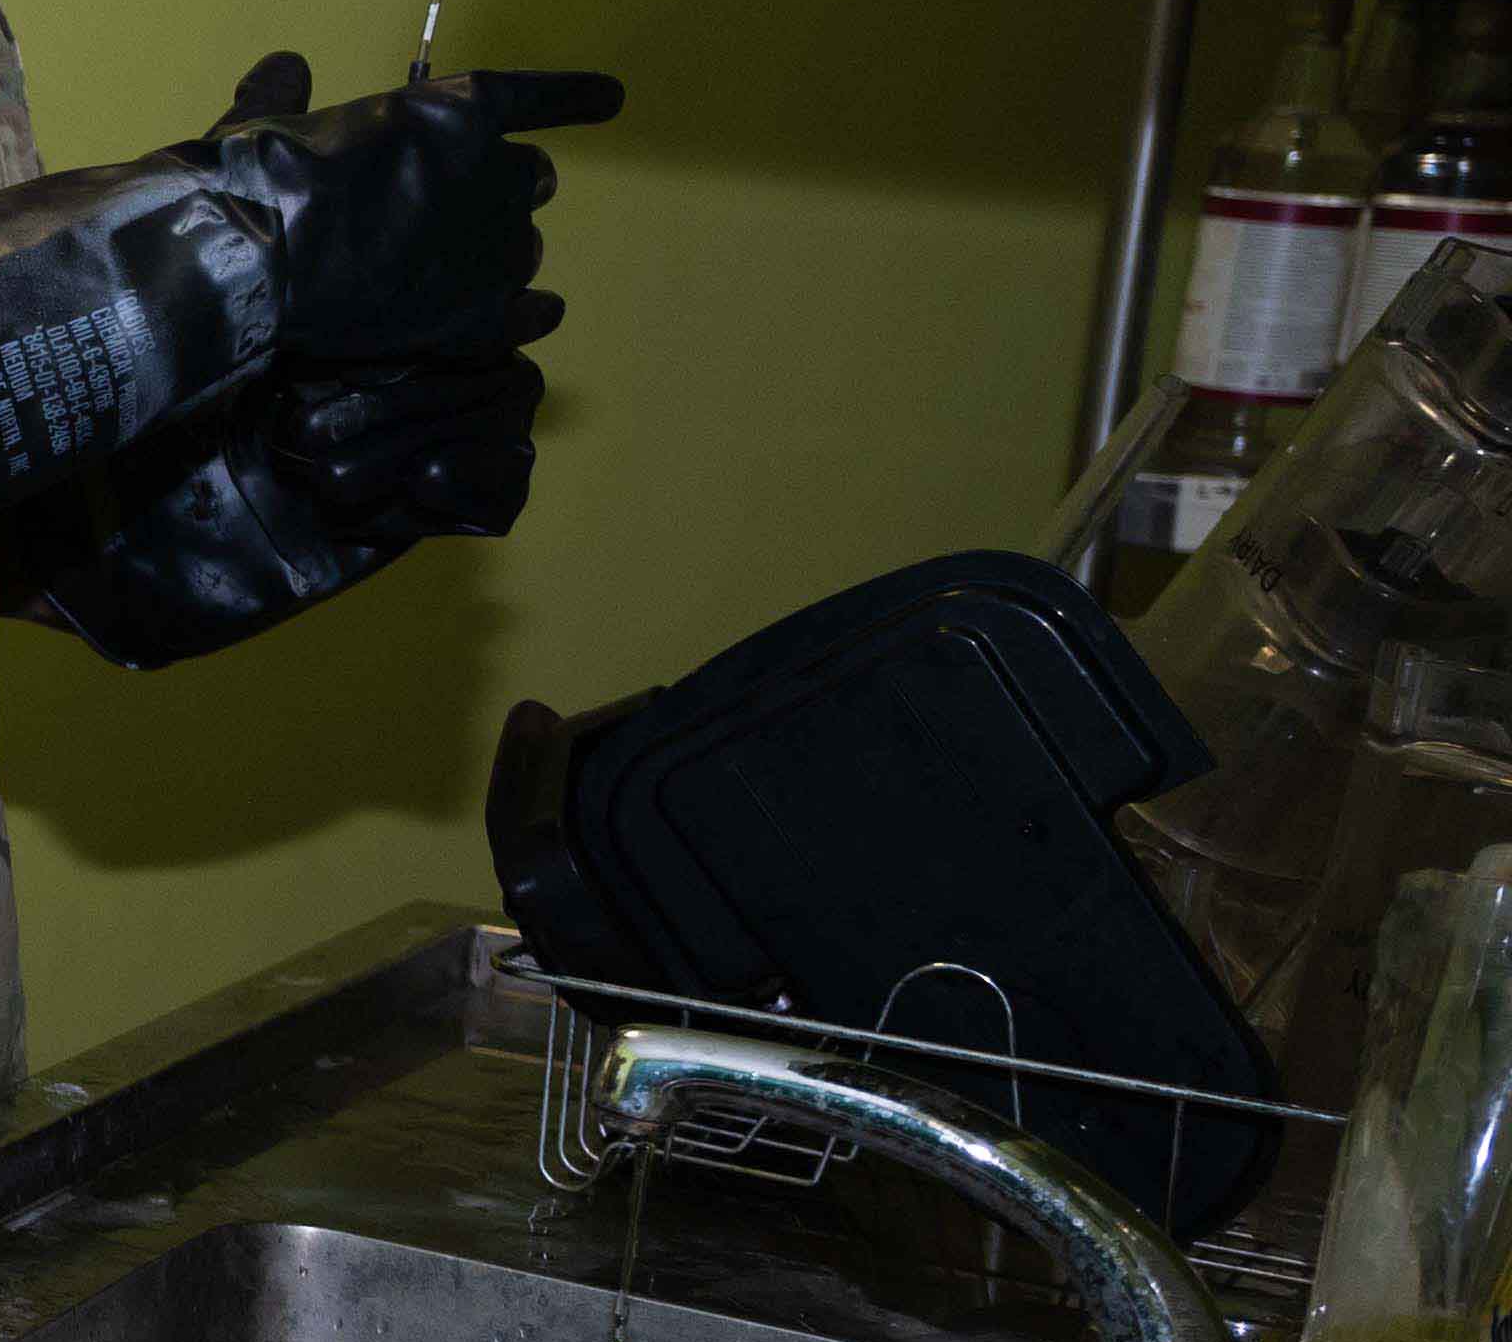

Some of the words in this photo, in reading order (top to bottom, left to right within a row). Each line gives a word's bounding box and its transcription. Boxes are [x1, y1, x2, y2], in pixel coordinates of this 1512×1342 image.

[91, 307, 135, 379] CHEMICAL
[115, 294, 156, 356] GLOVES
[0, 339, 35, 403] MEDIUM
